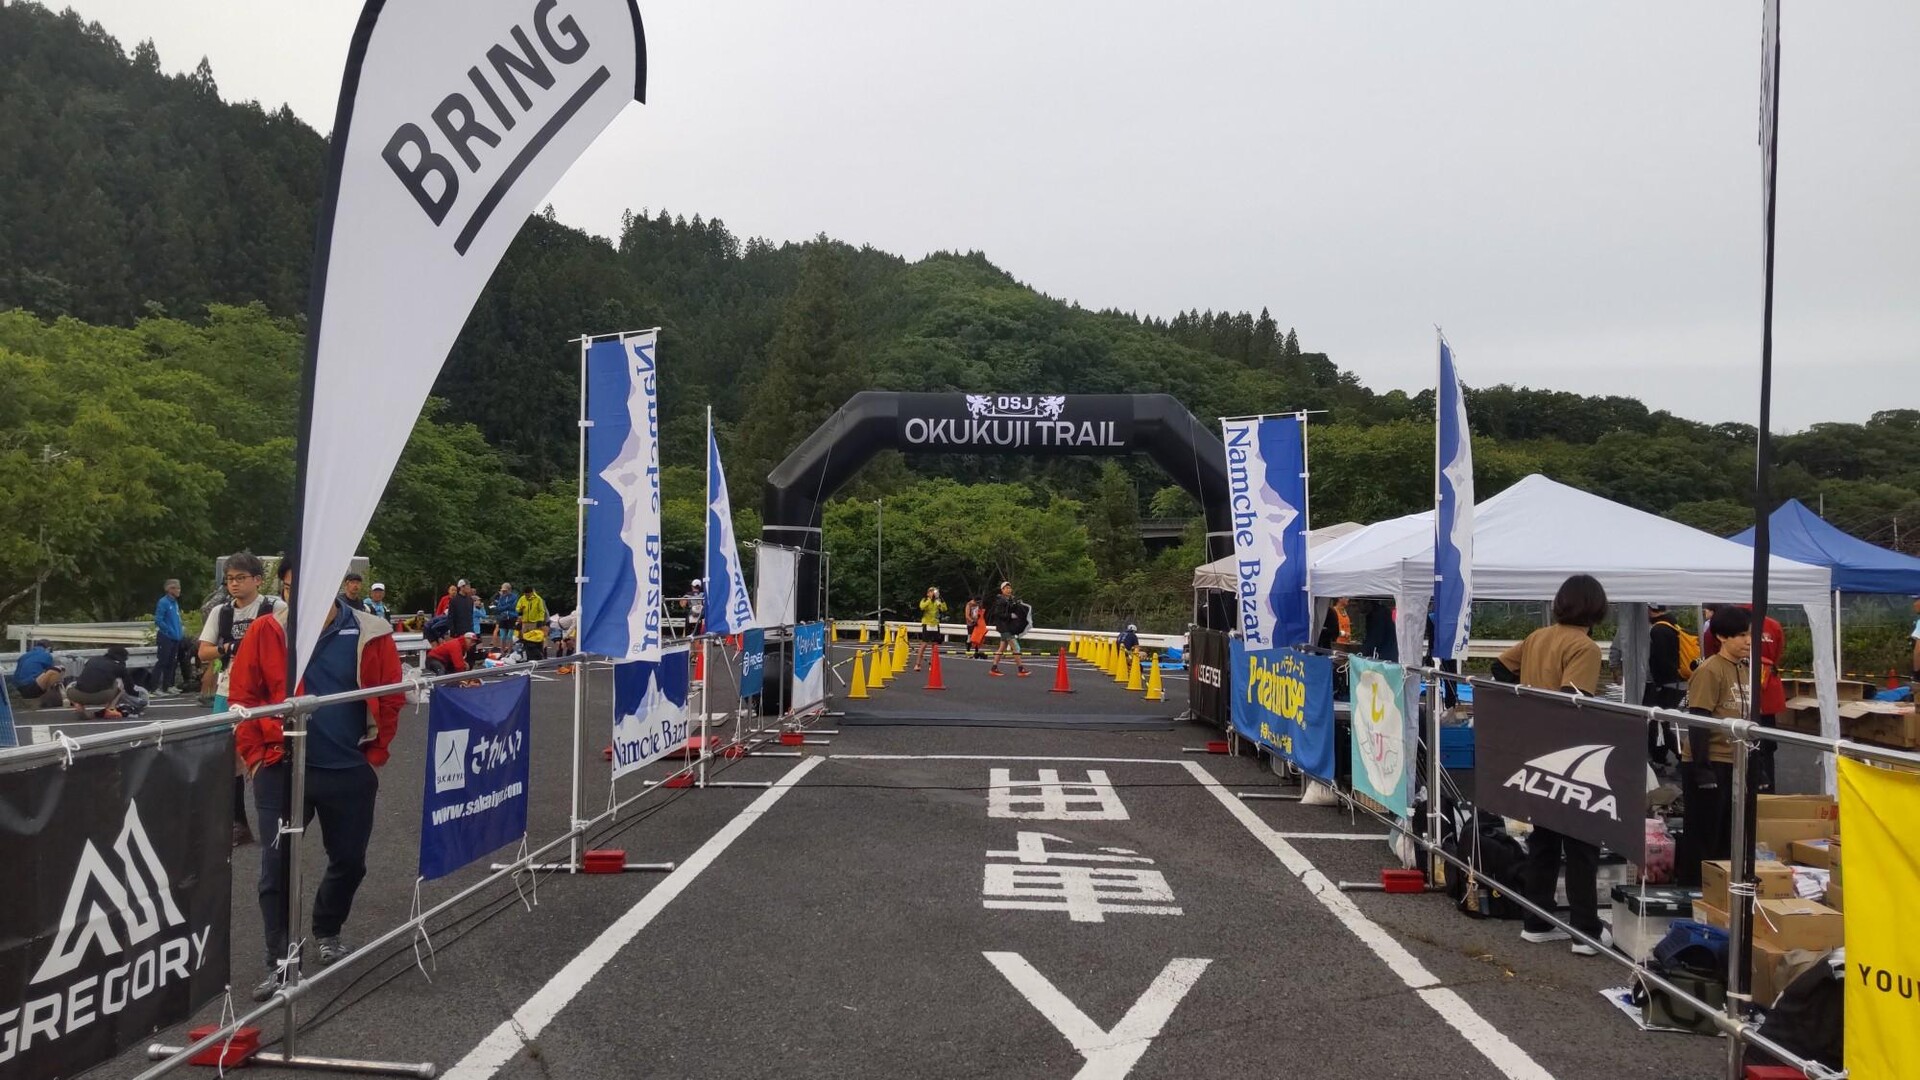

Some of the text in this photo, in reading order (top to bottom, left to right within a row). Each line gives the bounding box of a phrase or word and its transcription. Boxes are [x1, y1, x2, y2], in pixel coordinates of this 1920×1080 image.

[381, 0, 591, 227] BRING
[997, 396, 1033, 410] OSJ
[905, 418, 1125, 448] OKUKUJI TRAIL
[1225, 425, 1262, 644] Namche Bazar
[661, 720, 688, 749] Bazr
[1503, 768, 1618, 821] ALTRA
[0, 924, 211, 1064] GREGORY
[1858, 963, 1920, 1003] YOU
